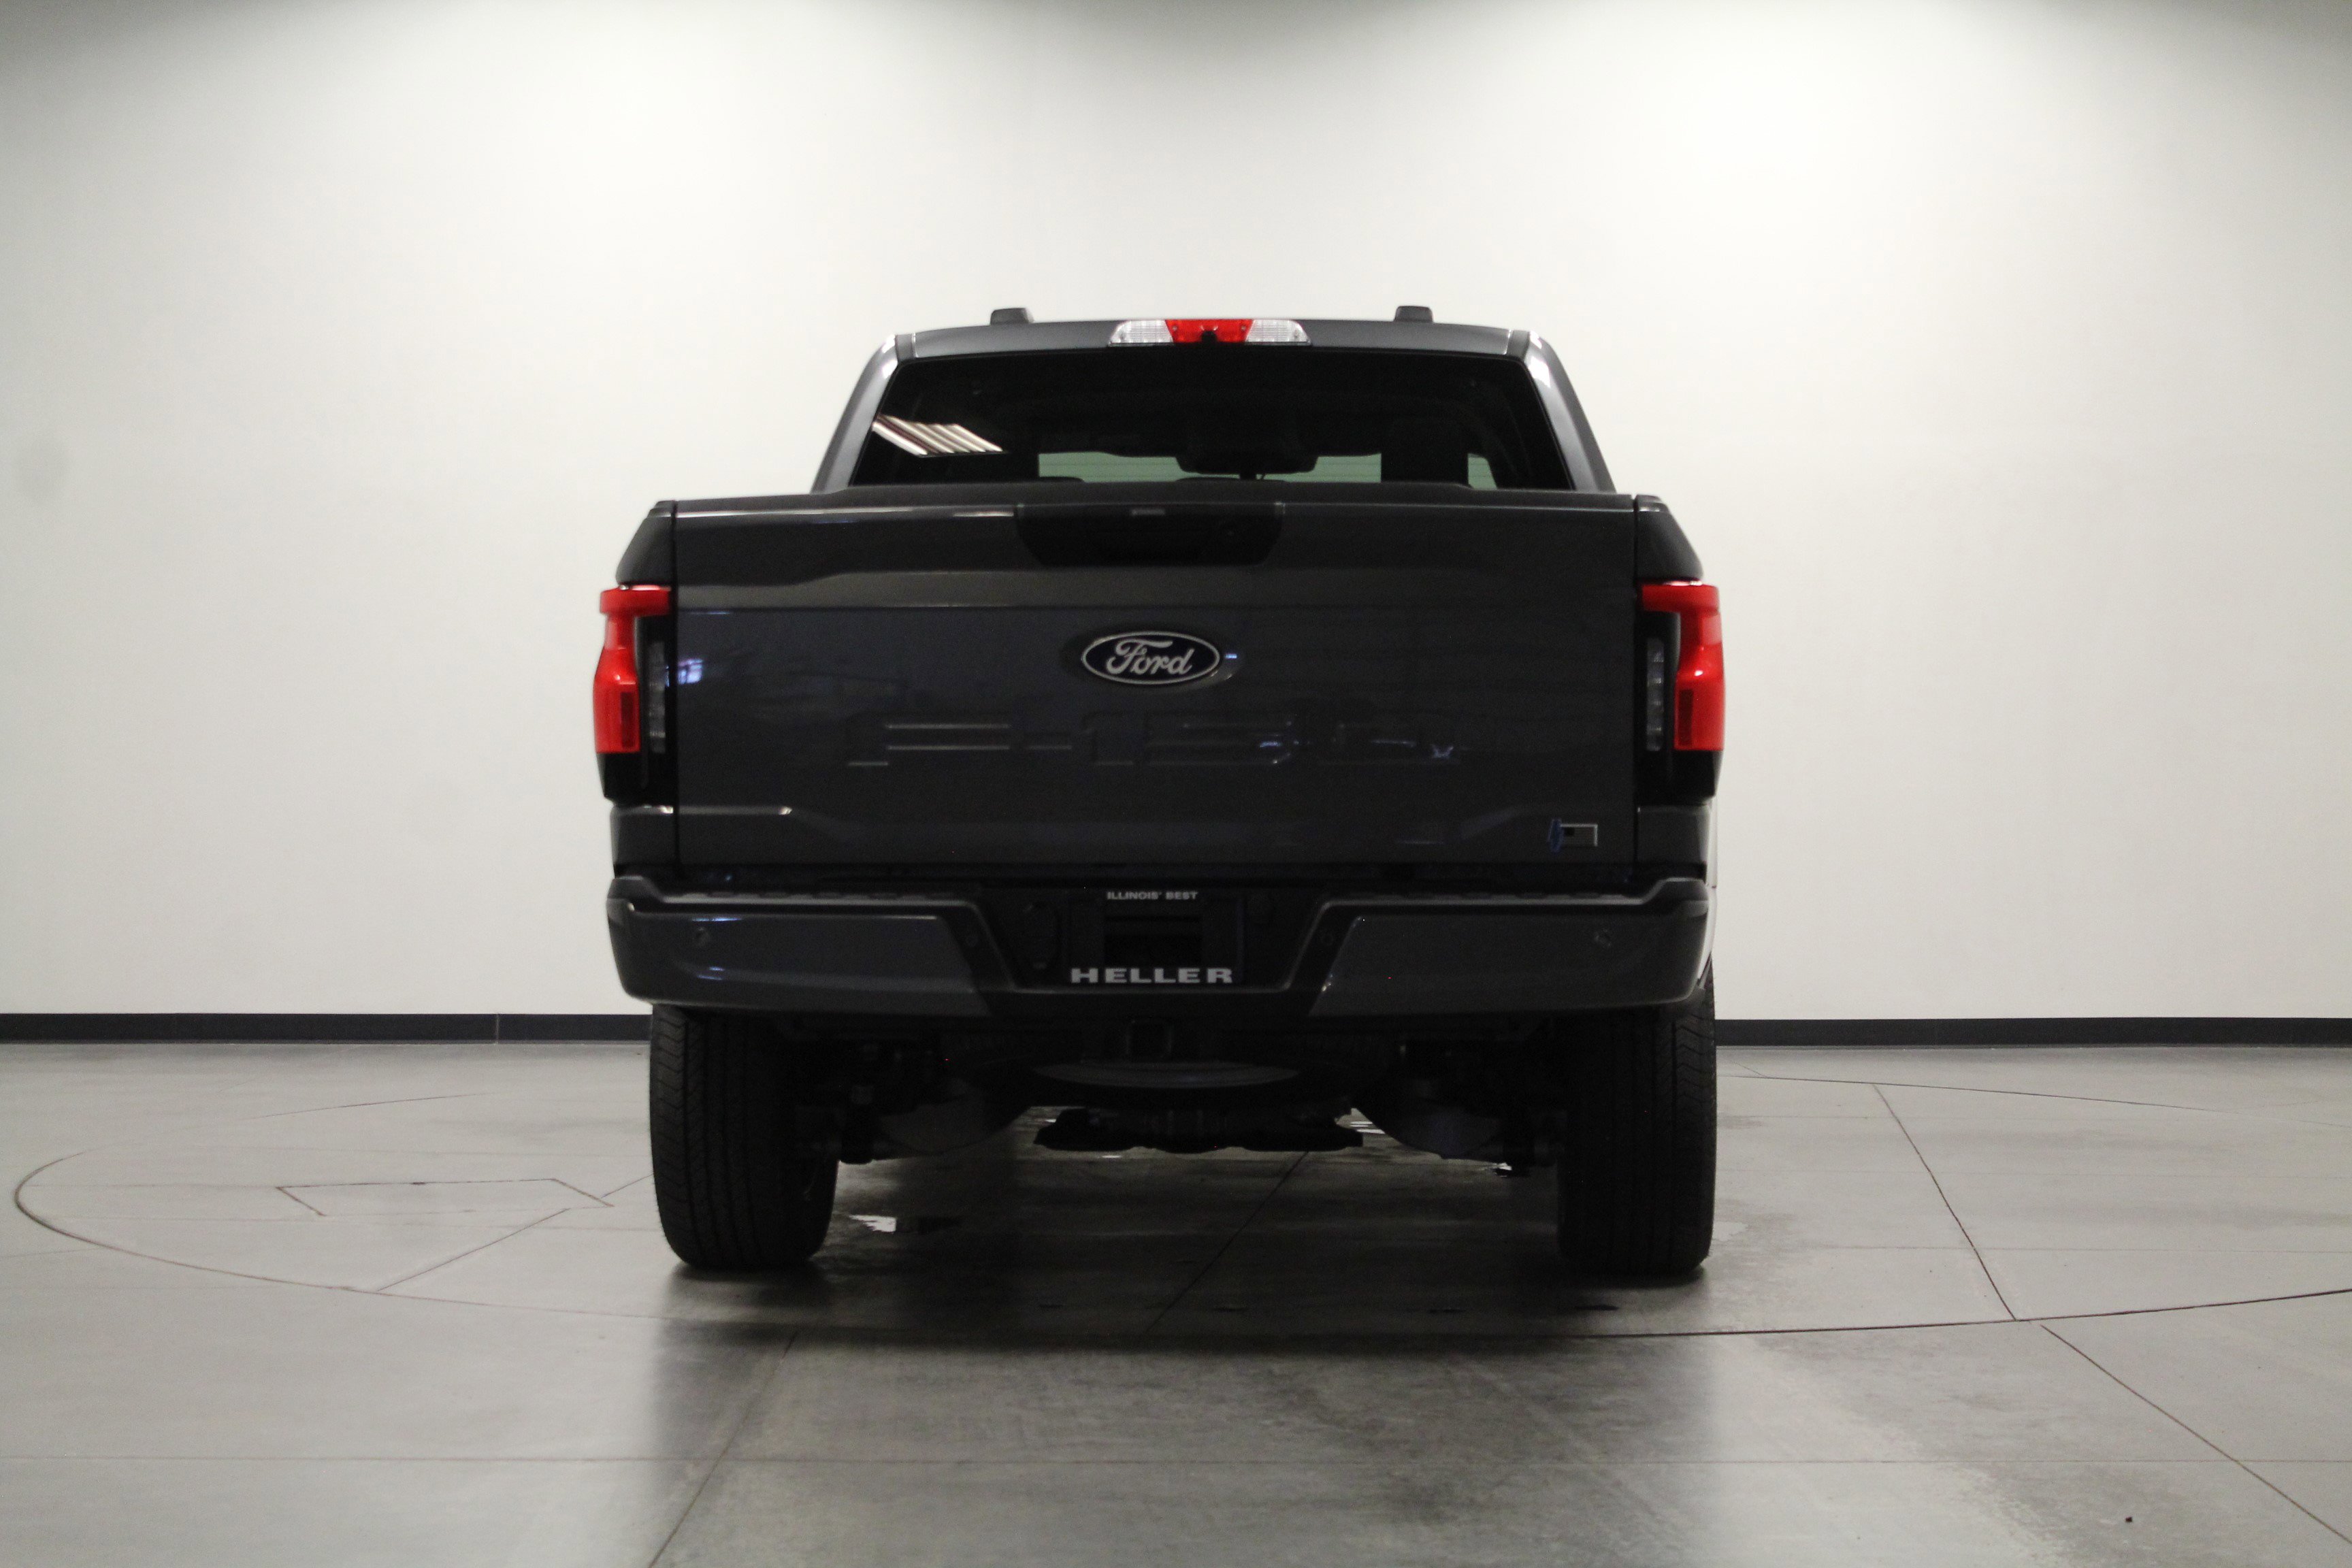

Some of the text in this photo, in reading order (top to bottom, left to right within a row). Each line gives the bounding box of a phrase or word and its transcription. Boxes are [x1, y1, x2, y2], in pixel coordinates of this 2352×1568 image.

[1106, 638, 1196, 675] Ford
[1165, 891, 1198, 900] BEST
[1071, 968, 1233, 984] HELLER
